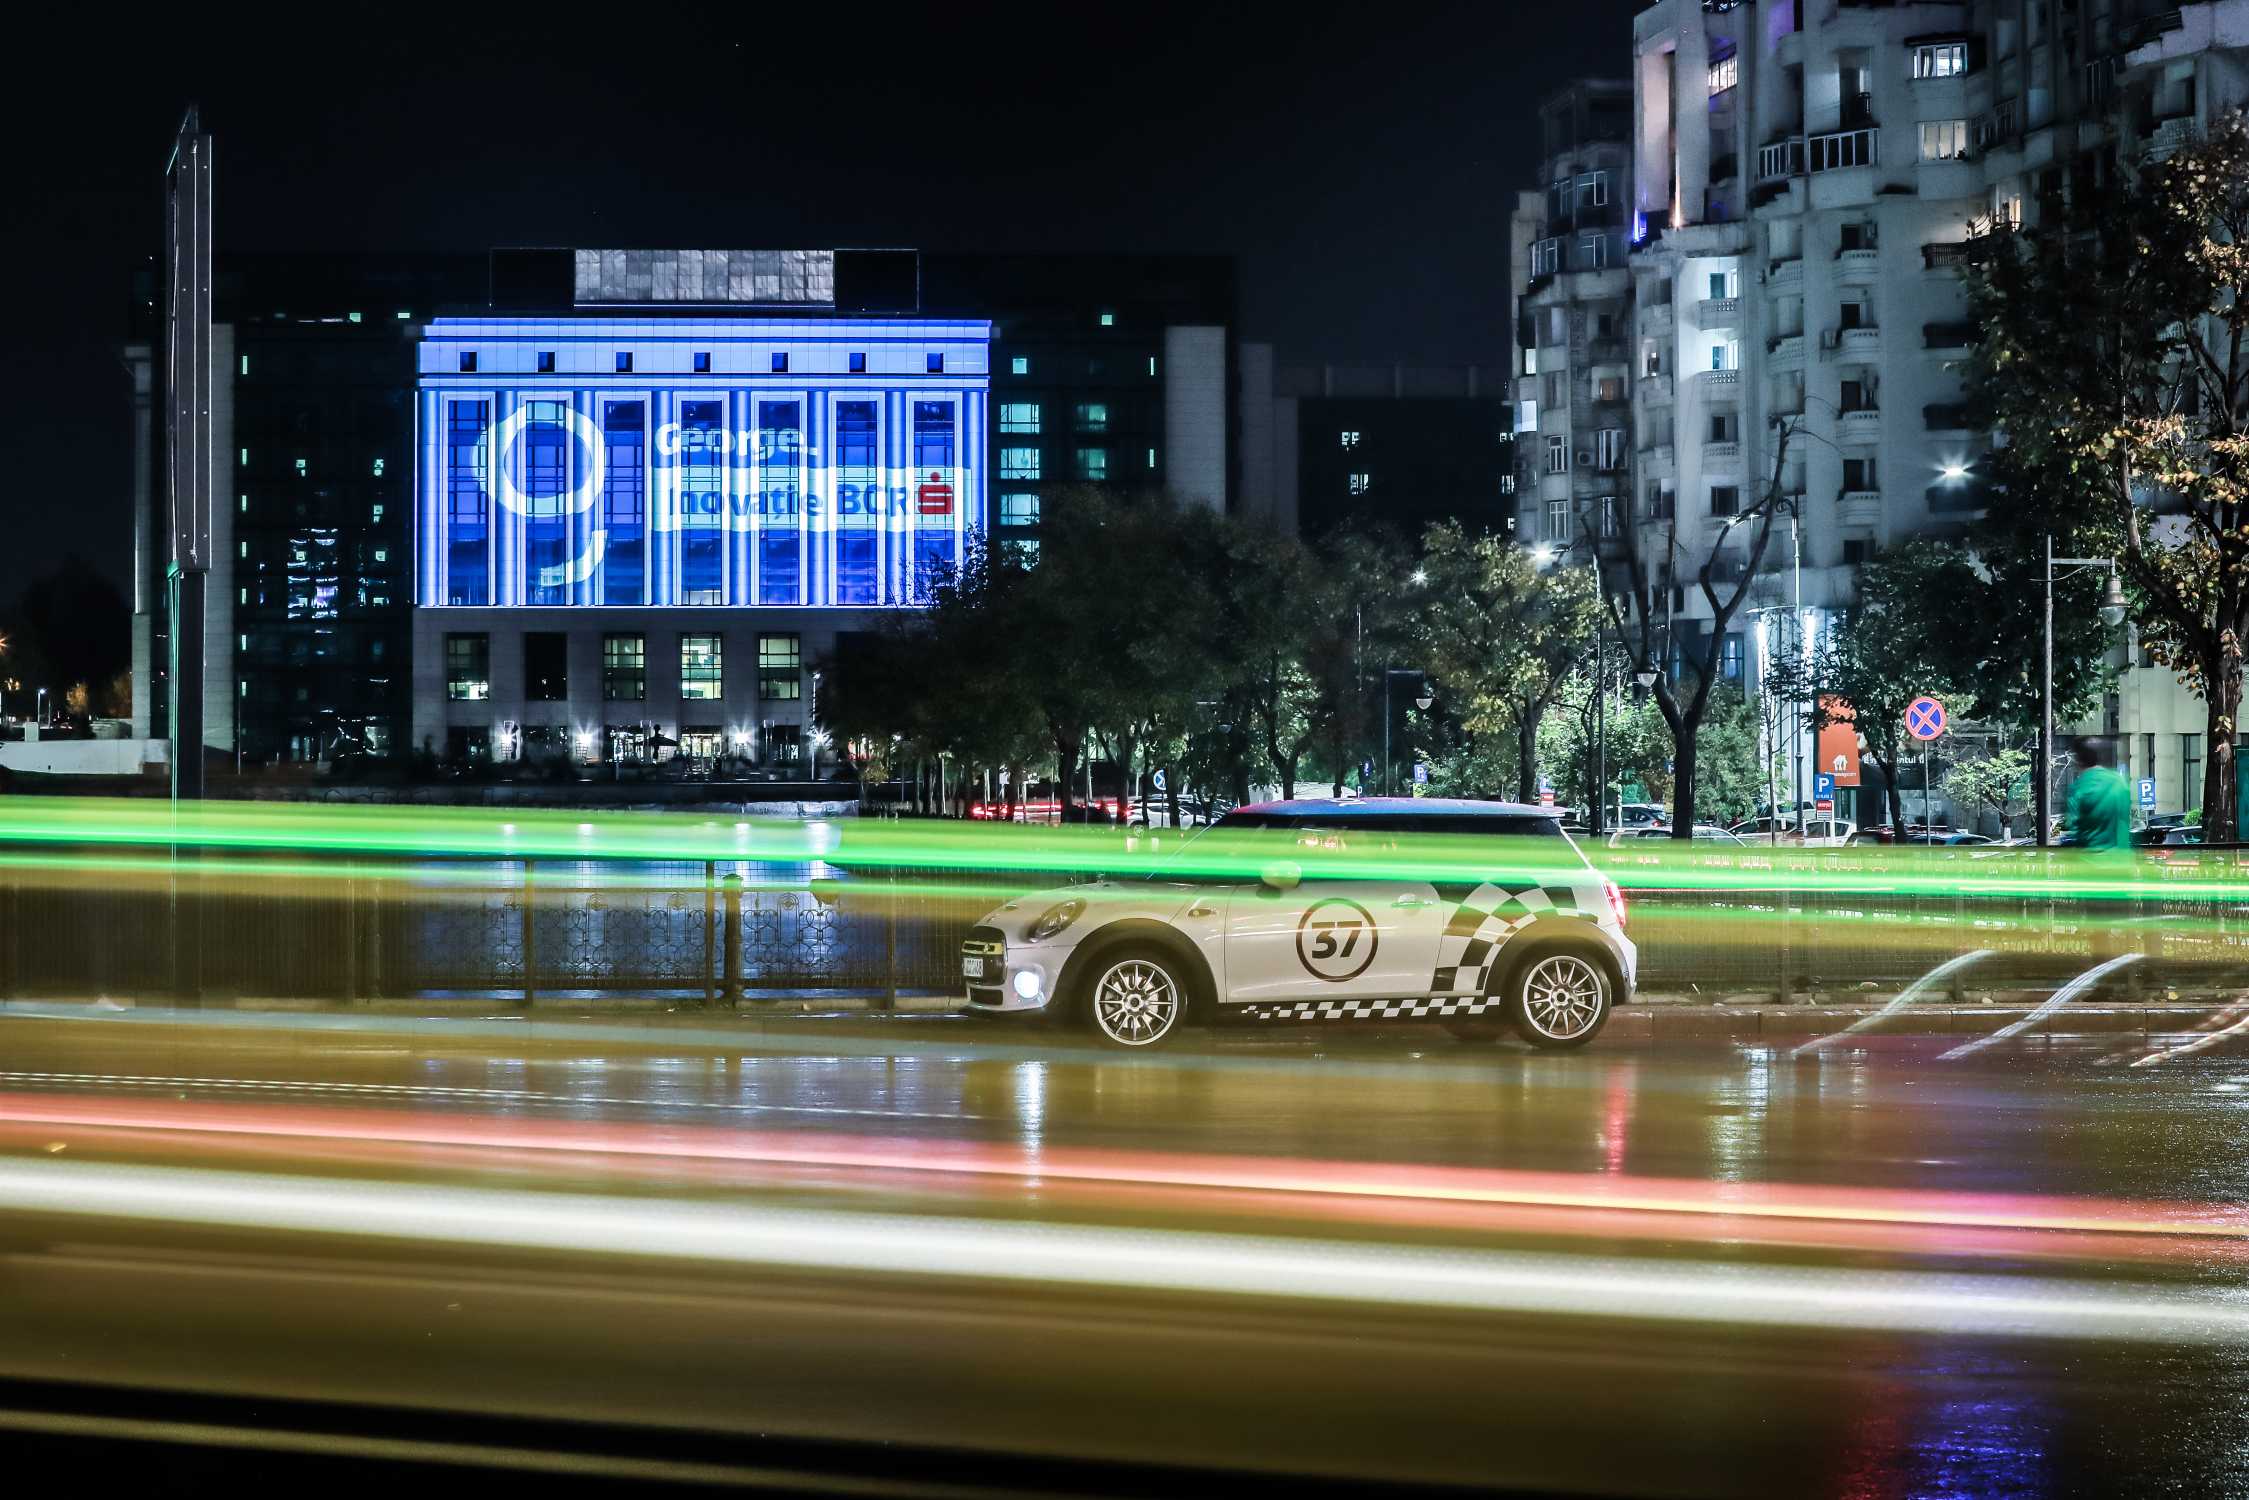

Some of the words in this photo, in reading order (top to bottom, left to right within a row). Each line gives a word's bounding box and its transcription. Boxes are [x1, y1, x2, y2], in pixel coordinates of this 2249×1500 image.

[836, 484, 911, 517] BCR
[1818, 777, 1830, 793] P
[2141, 782, 2152, 798] P
[1311, 920, 1363, 960] 37
